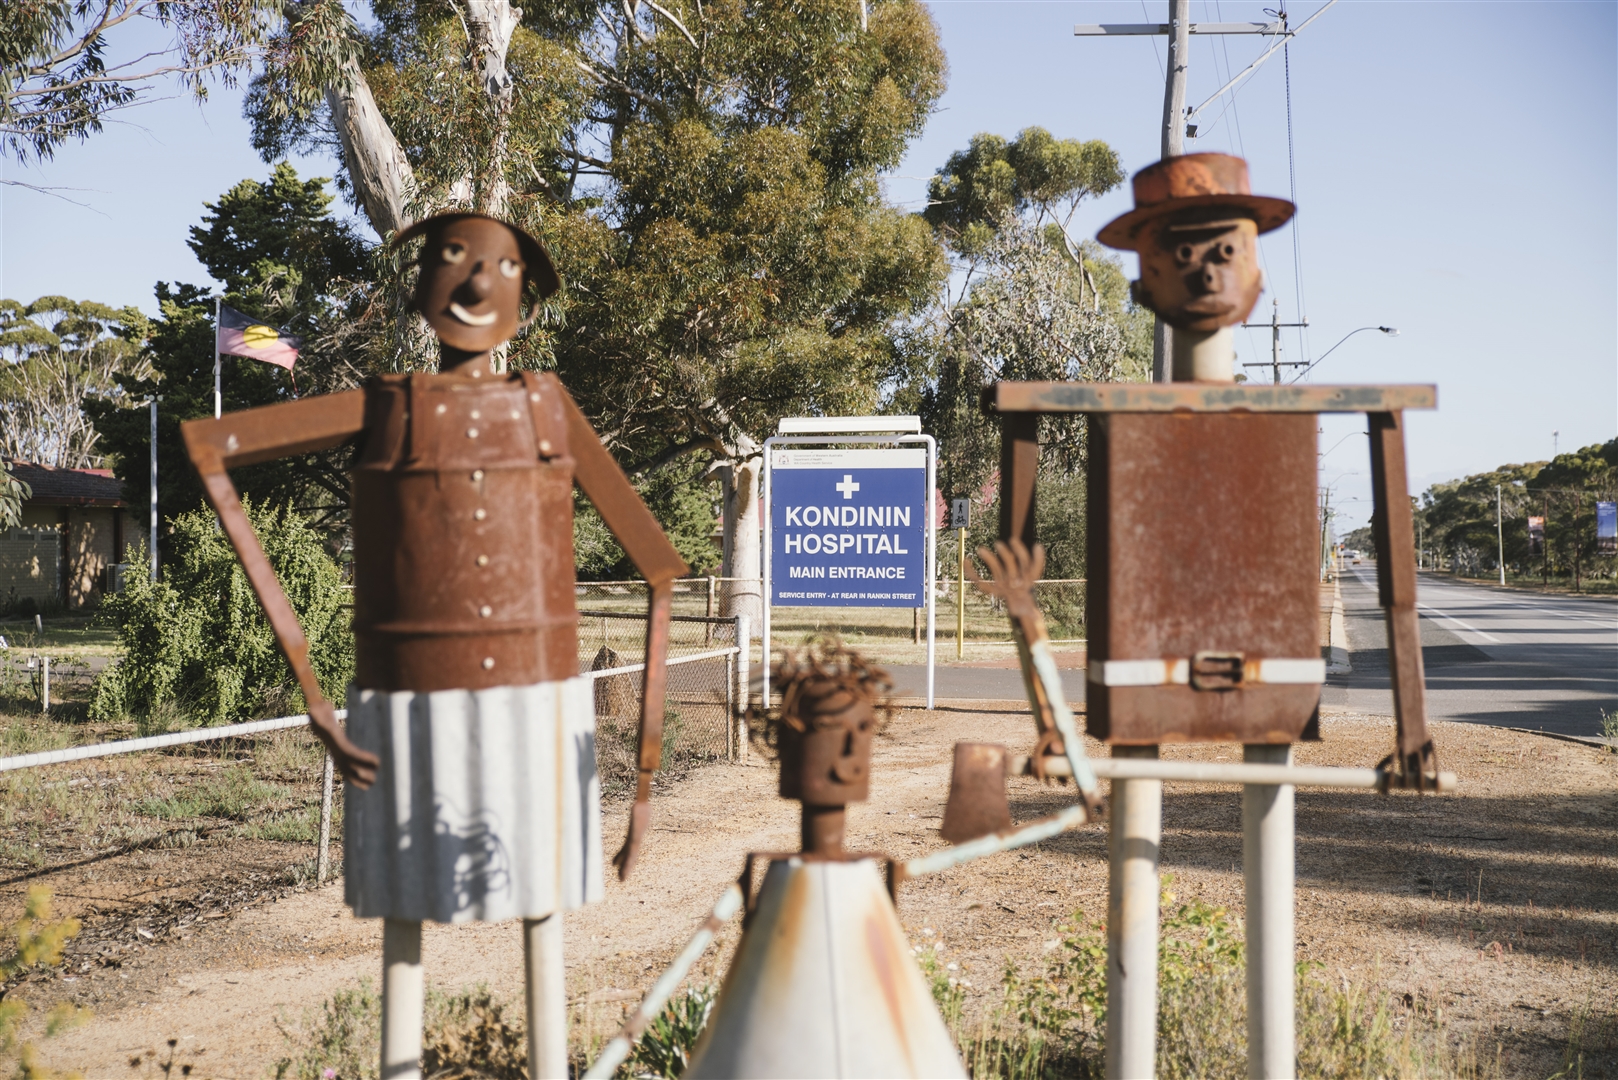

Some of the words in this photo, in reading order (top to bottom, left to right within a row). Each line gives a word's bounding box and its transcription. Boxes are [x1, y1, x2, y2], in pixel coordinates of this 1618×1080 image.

[786, 506, 910, 526] KONDININ
[785, 534, 908, 554] HOSPITAL
[790, 566, 825, 578] MAIN
[829, 567, 905, 579] ENTRANCE
